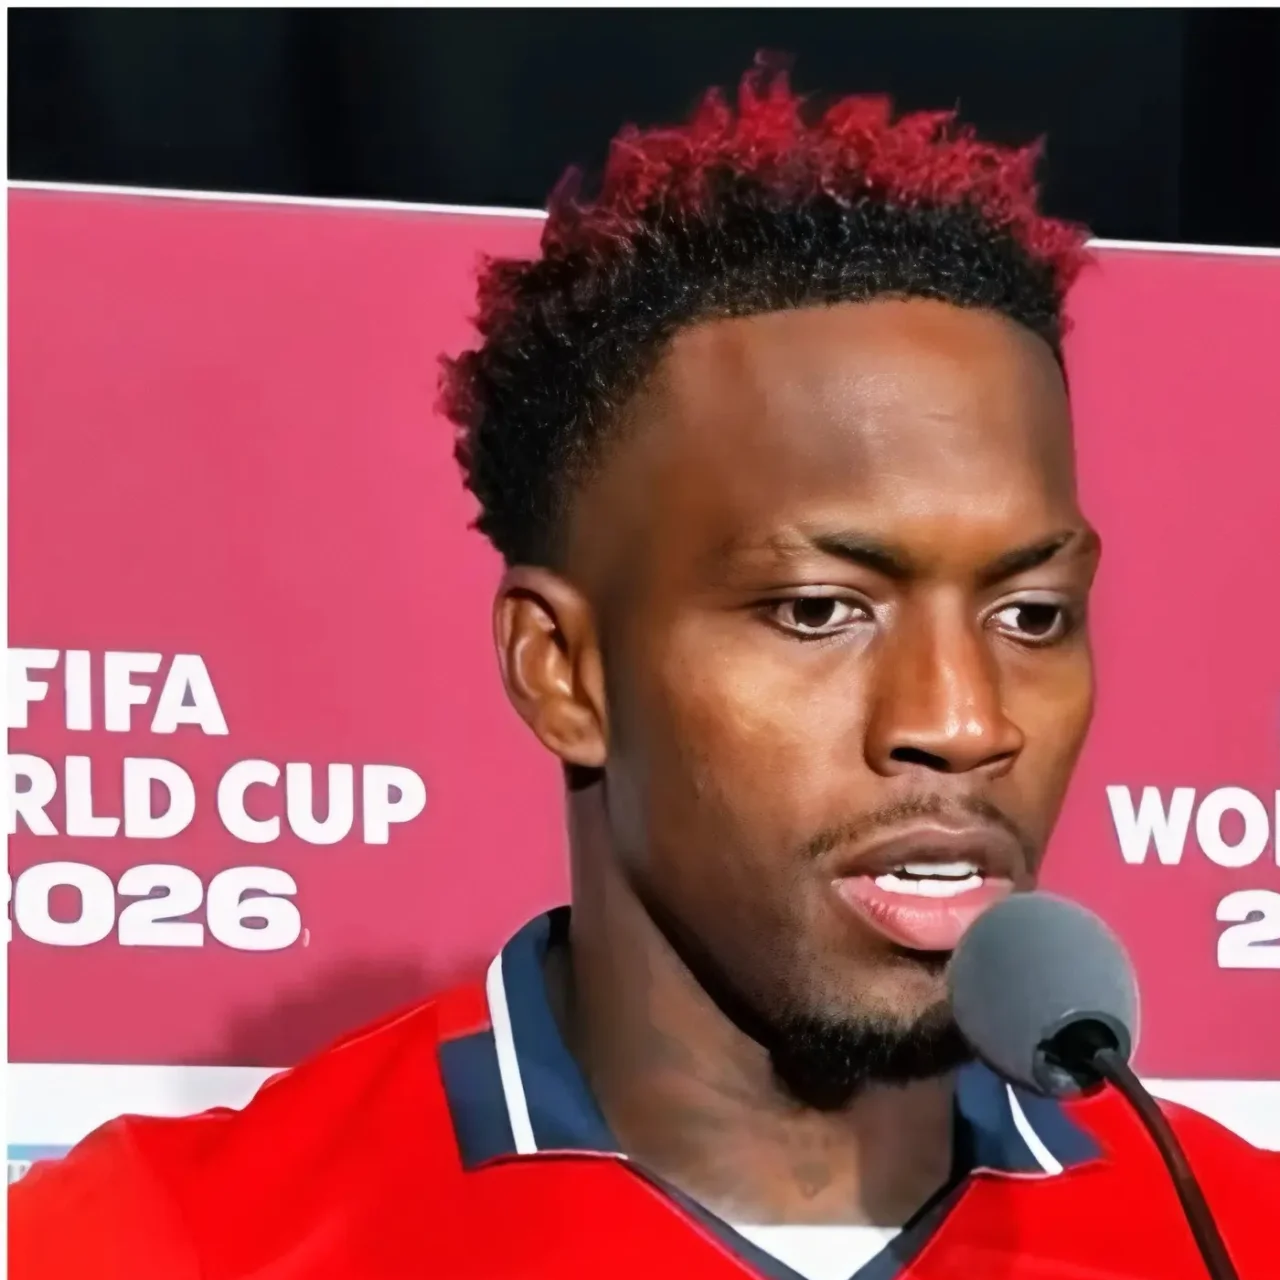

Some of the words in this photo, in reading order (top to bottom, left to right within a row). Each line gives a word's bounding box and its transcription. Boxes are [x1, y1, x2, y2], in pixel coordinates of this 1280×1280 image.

[8, 648, 229, 735] FIFA
[217, 759, 427, 846] CUP
[8, 861, 302, 952] 026
